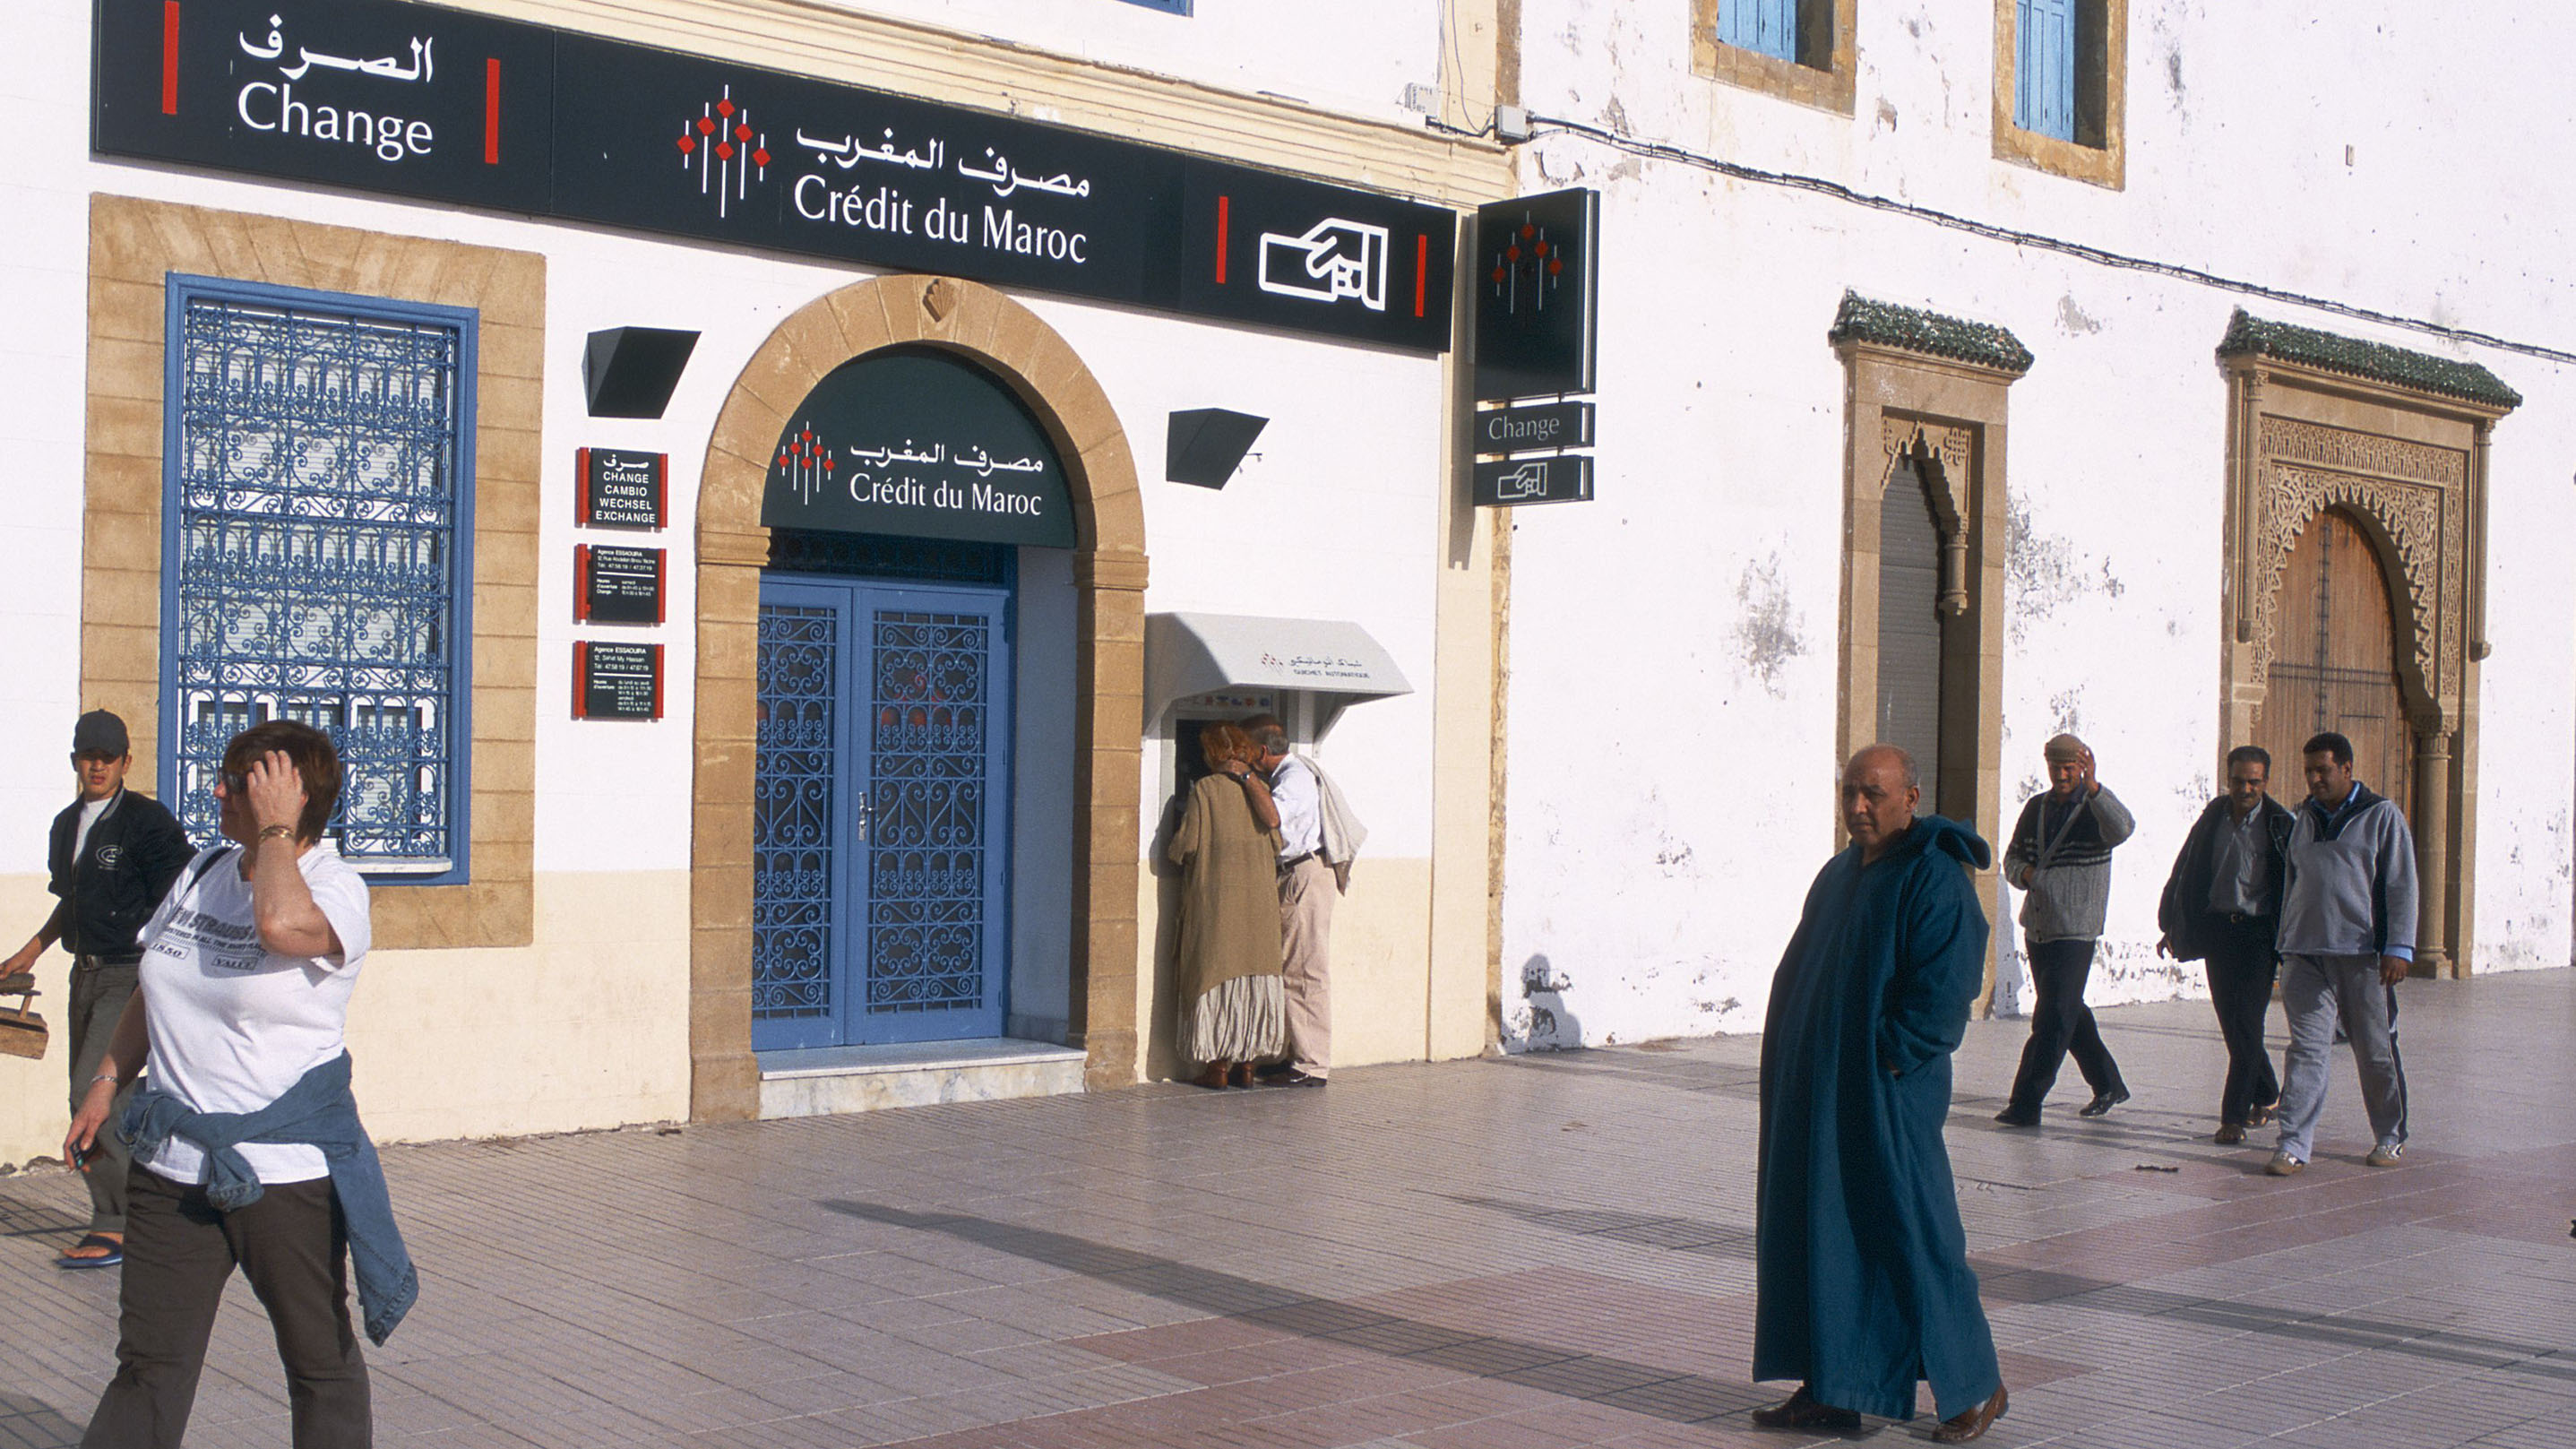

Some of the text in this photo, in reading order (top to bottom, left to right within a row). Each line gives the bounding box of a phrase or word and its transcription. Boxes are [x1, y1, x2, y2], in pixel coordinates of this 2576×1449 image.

[239, 13, 434, 83] الصرف
[237, 82, 434, 161] Change
[796, 127, 1090, 198] مصرف المغرب
[794, 174, 1087, 263] Crédit du Maroc
[1488, 415, 1560, 442] Change
[603, 453, 650, 472] صرف
[850, 438, 1044, 478] مصرف المغرب
[603, 470, 650, 484] CHANGE
[605, 484, 648, 497] CAMBIO
[599, 497, 652, 510] WECHSEL
[849, 472, 1042, 516] Crédit du Maroc
[595, 510, 656, 523] EXCHANGE
